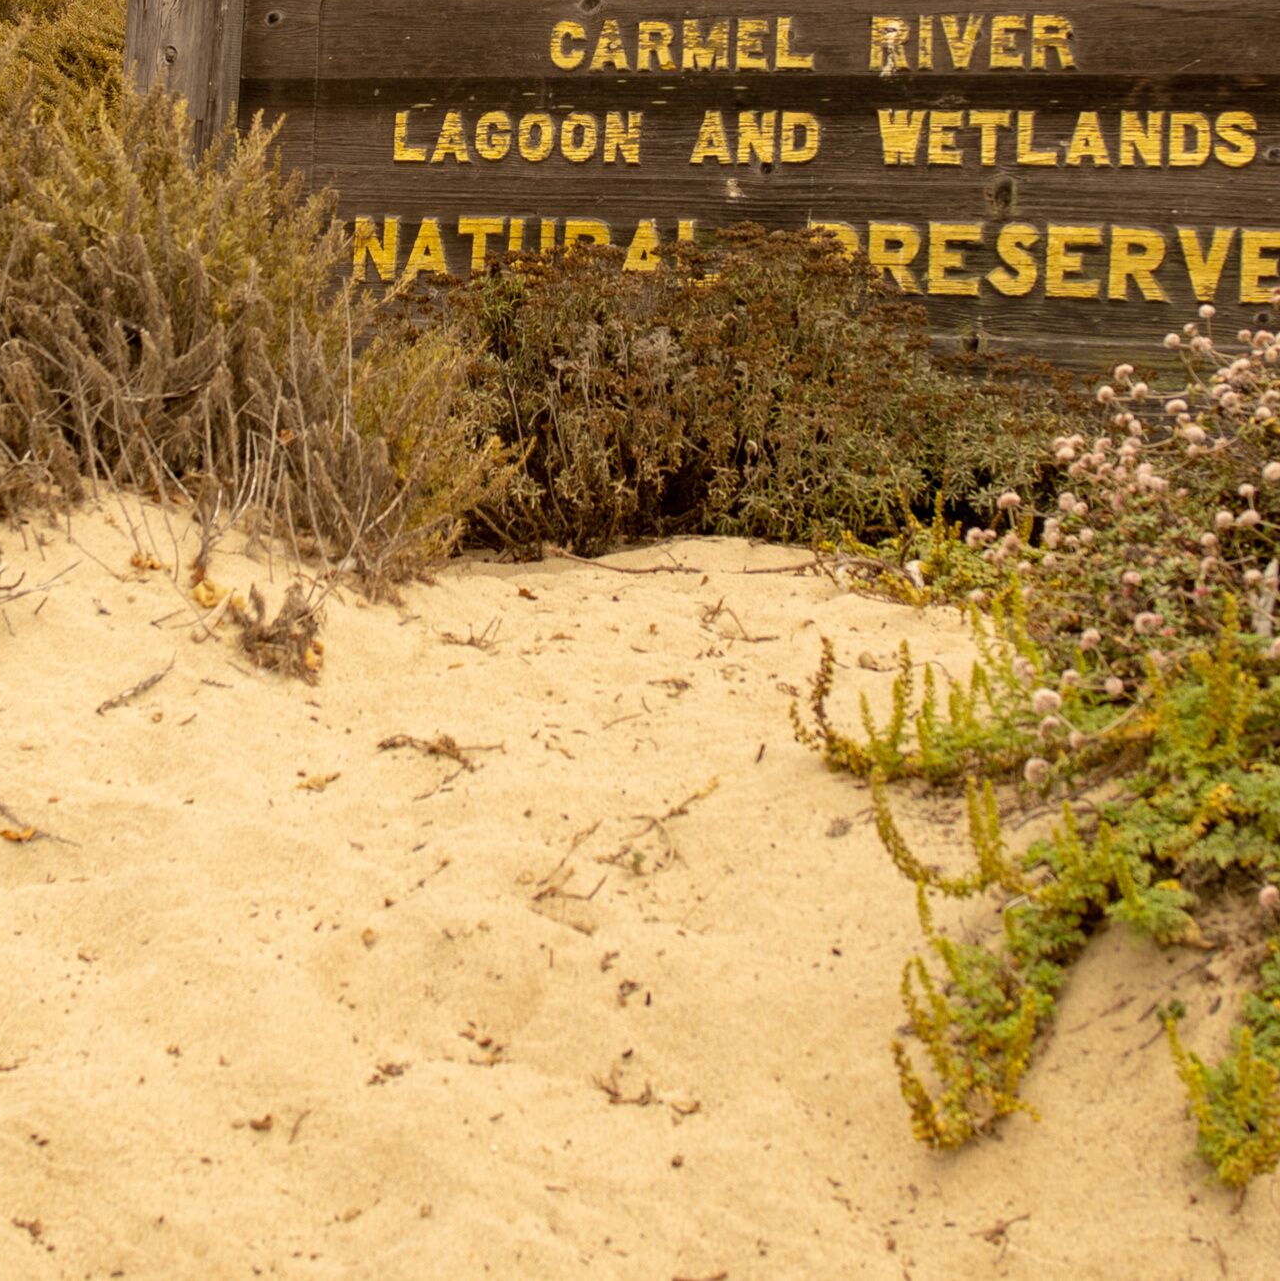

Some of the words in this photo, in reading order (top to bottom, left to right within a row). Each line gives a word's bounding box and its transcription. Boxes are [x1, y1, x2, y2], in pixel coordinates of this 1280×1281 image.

[549, 16, 815, 72] CARMEL
[869, 14, 1079, 73] RIVER
[392, 111, 642, 164] LAGOON
[689, 110, 820, 165] AND
[877, 109, 1258, 167] WETLANDS
